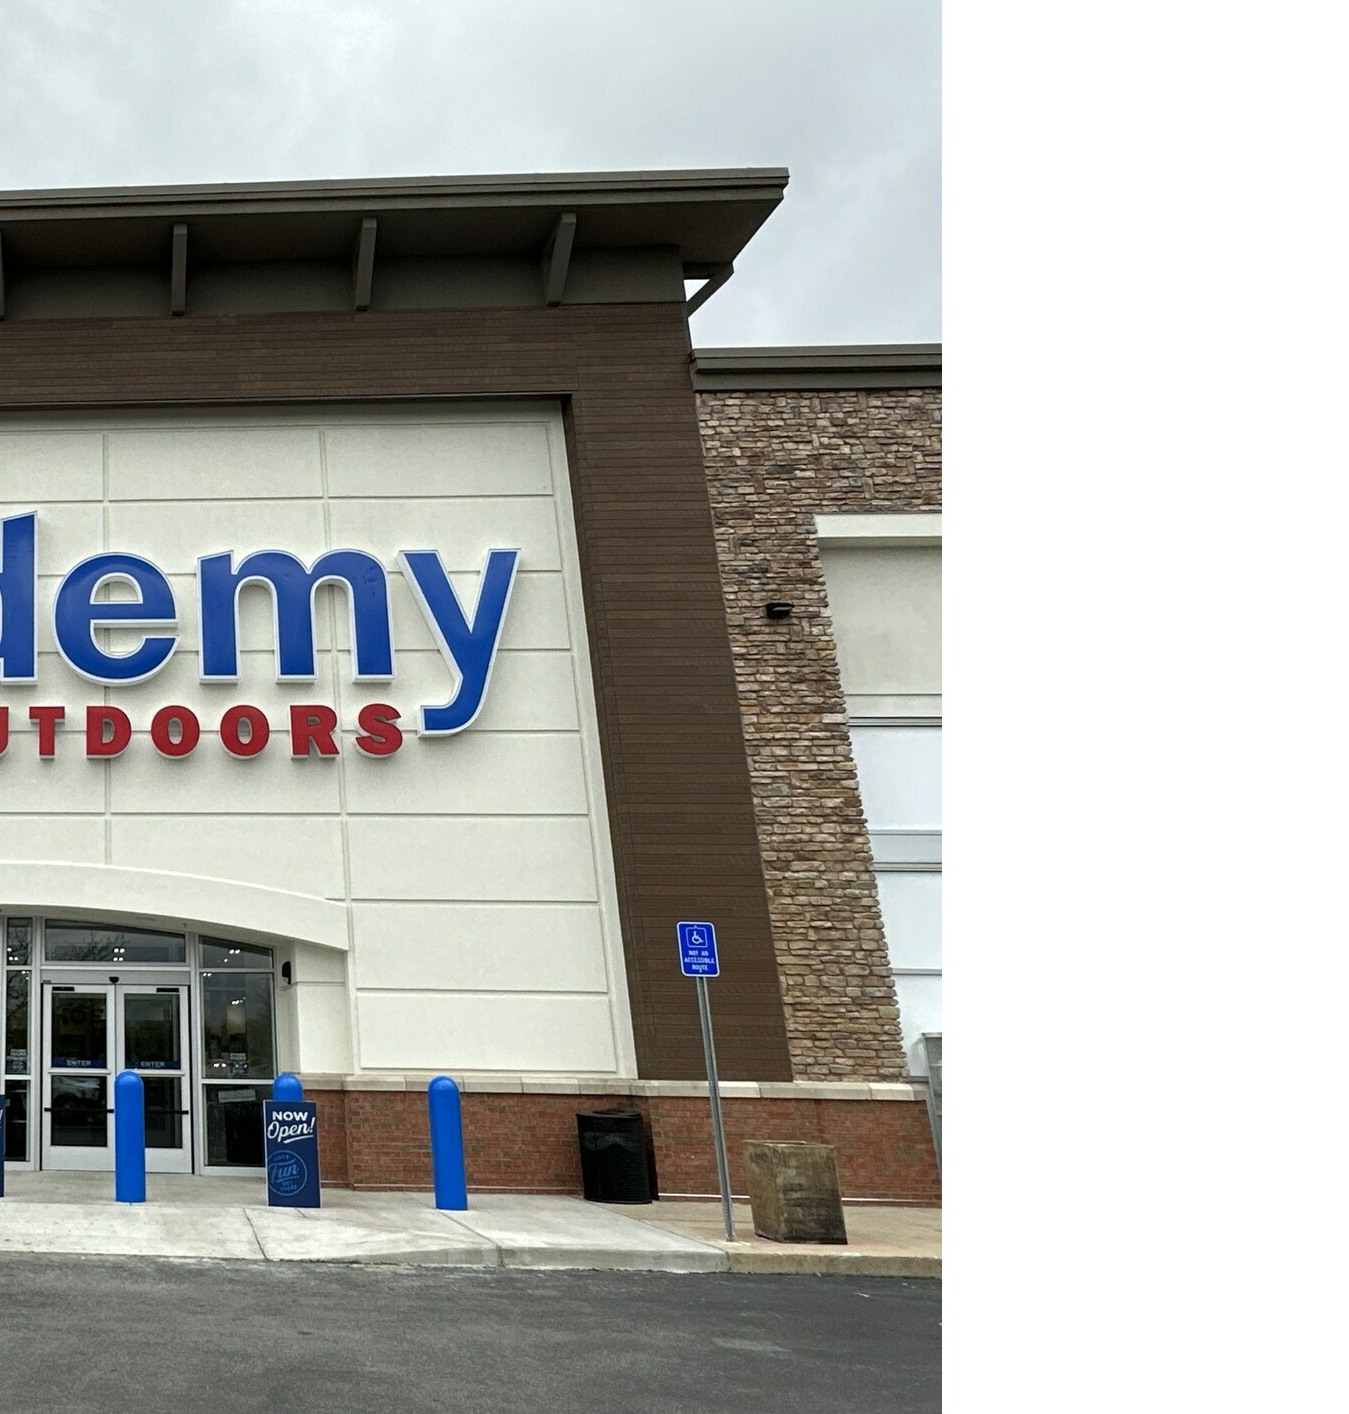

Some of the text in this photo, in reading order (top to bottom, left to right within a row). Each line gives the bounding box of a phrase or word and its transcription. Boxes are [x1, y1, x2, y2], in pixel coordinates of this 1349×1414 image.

[66, 1059, 91, 1067] ENTER
[272, 1111, 308, 1121] NOW
[267, 1116, 315, 1143] Open!
[268, 1158, 300, 1184] Fun
